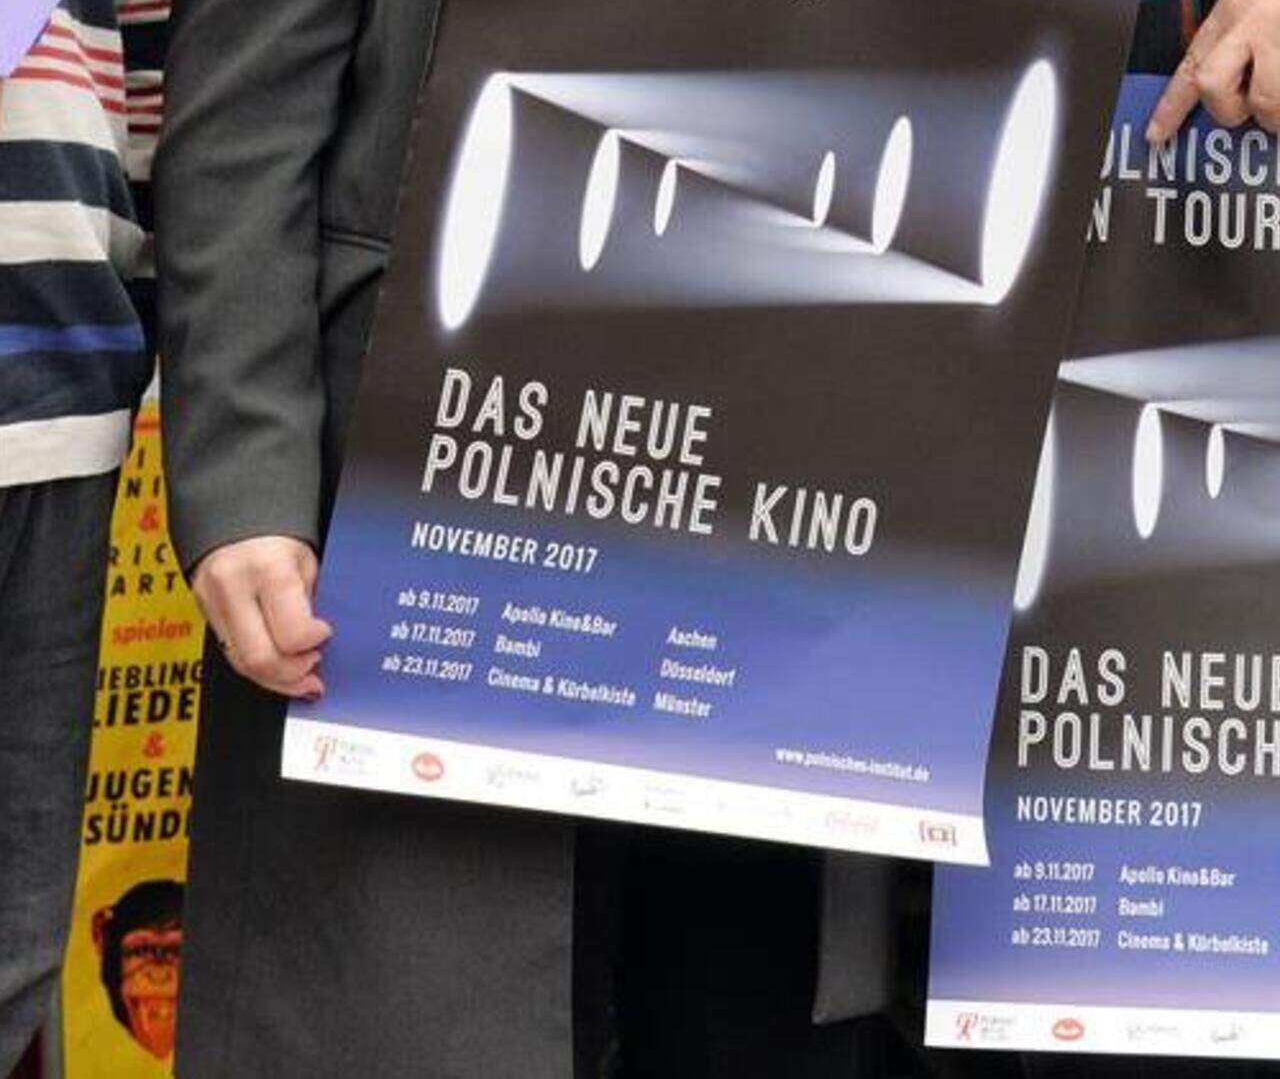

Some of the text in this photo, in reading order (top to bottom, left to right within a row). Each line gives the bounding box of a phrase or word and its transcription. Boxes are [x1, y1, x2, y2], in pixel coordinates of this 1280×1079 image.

[435, 367, 713, 466] DAS NEUE
[421, 433, 879, 556] POLNISCHE KINO
[411, 520, 599, 574] NOVEMBER 2017
[390, 622, 410, 642] ab
[494, 634, 542, 660] Bambi
[398, 589, 415, 607] ab
[666, 626, 718, 652] Aachen
[382, 654, 401, 672] ab
[487, 668, 541, 694] Cinema
[1020, 645, 1127, 706] DAS
[93, 687, 196, 728] IEDE
[84, 803, 190, 846] SÜND
[1017, 795, 1202, 828] NOVEMBER 2017
[1013, 861, 1033, 880] ab
[1012, 893, 1032, 912] ab
[1011, 926, 1031, 945] ab
